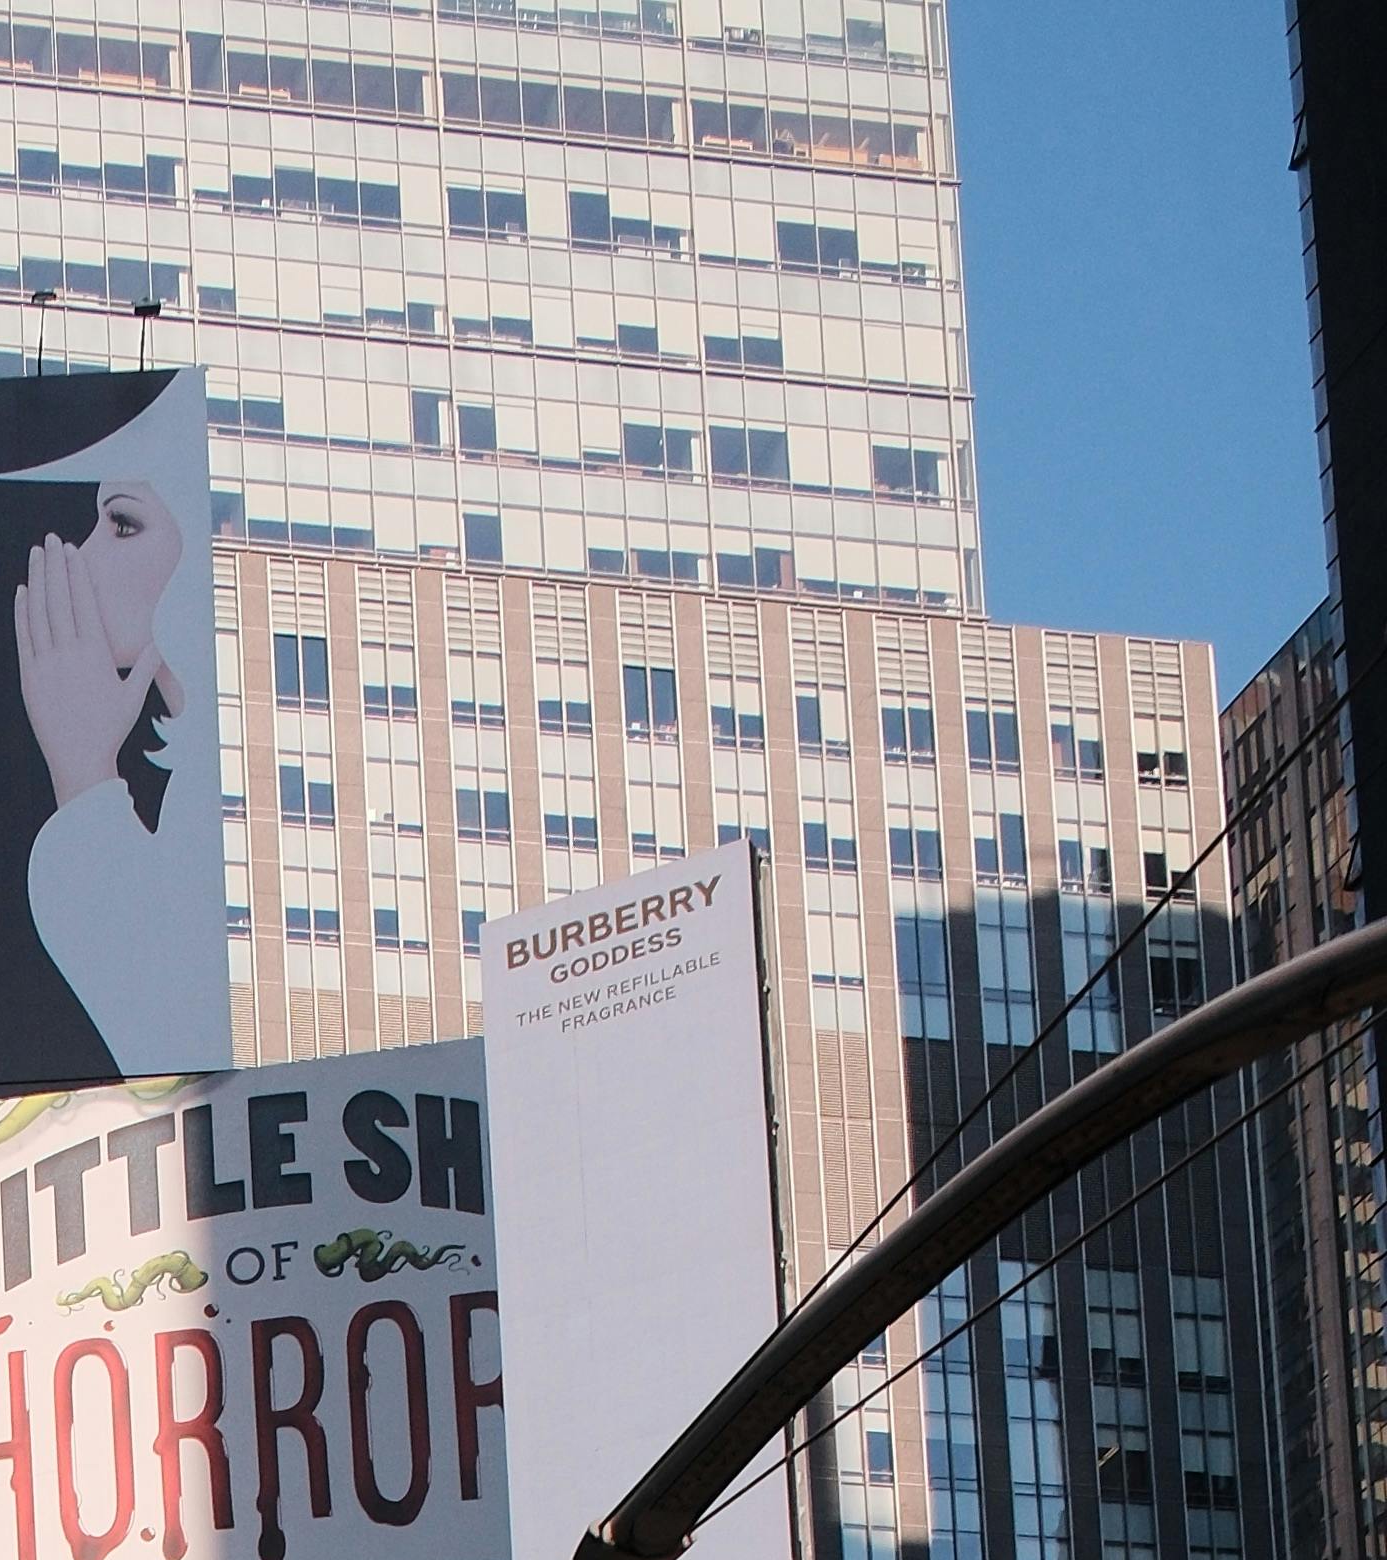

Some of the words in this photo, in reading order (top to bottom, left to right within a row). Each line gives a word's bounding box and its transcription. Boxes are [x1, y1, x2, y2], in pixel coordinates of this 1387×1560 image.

[507, 875, 722, 969] BURBERRY
[551, 928, 682, 983] GODDESS
[516, 1005, 551, 1027] THE
[558, 989, 602, 1012] NEW
[608, 952, 721, 999] REFILLABLE
[561, 986, 676, 1033] FRAGRANCE
[228, 1242, 299, 1285] OF
